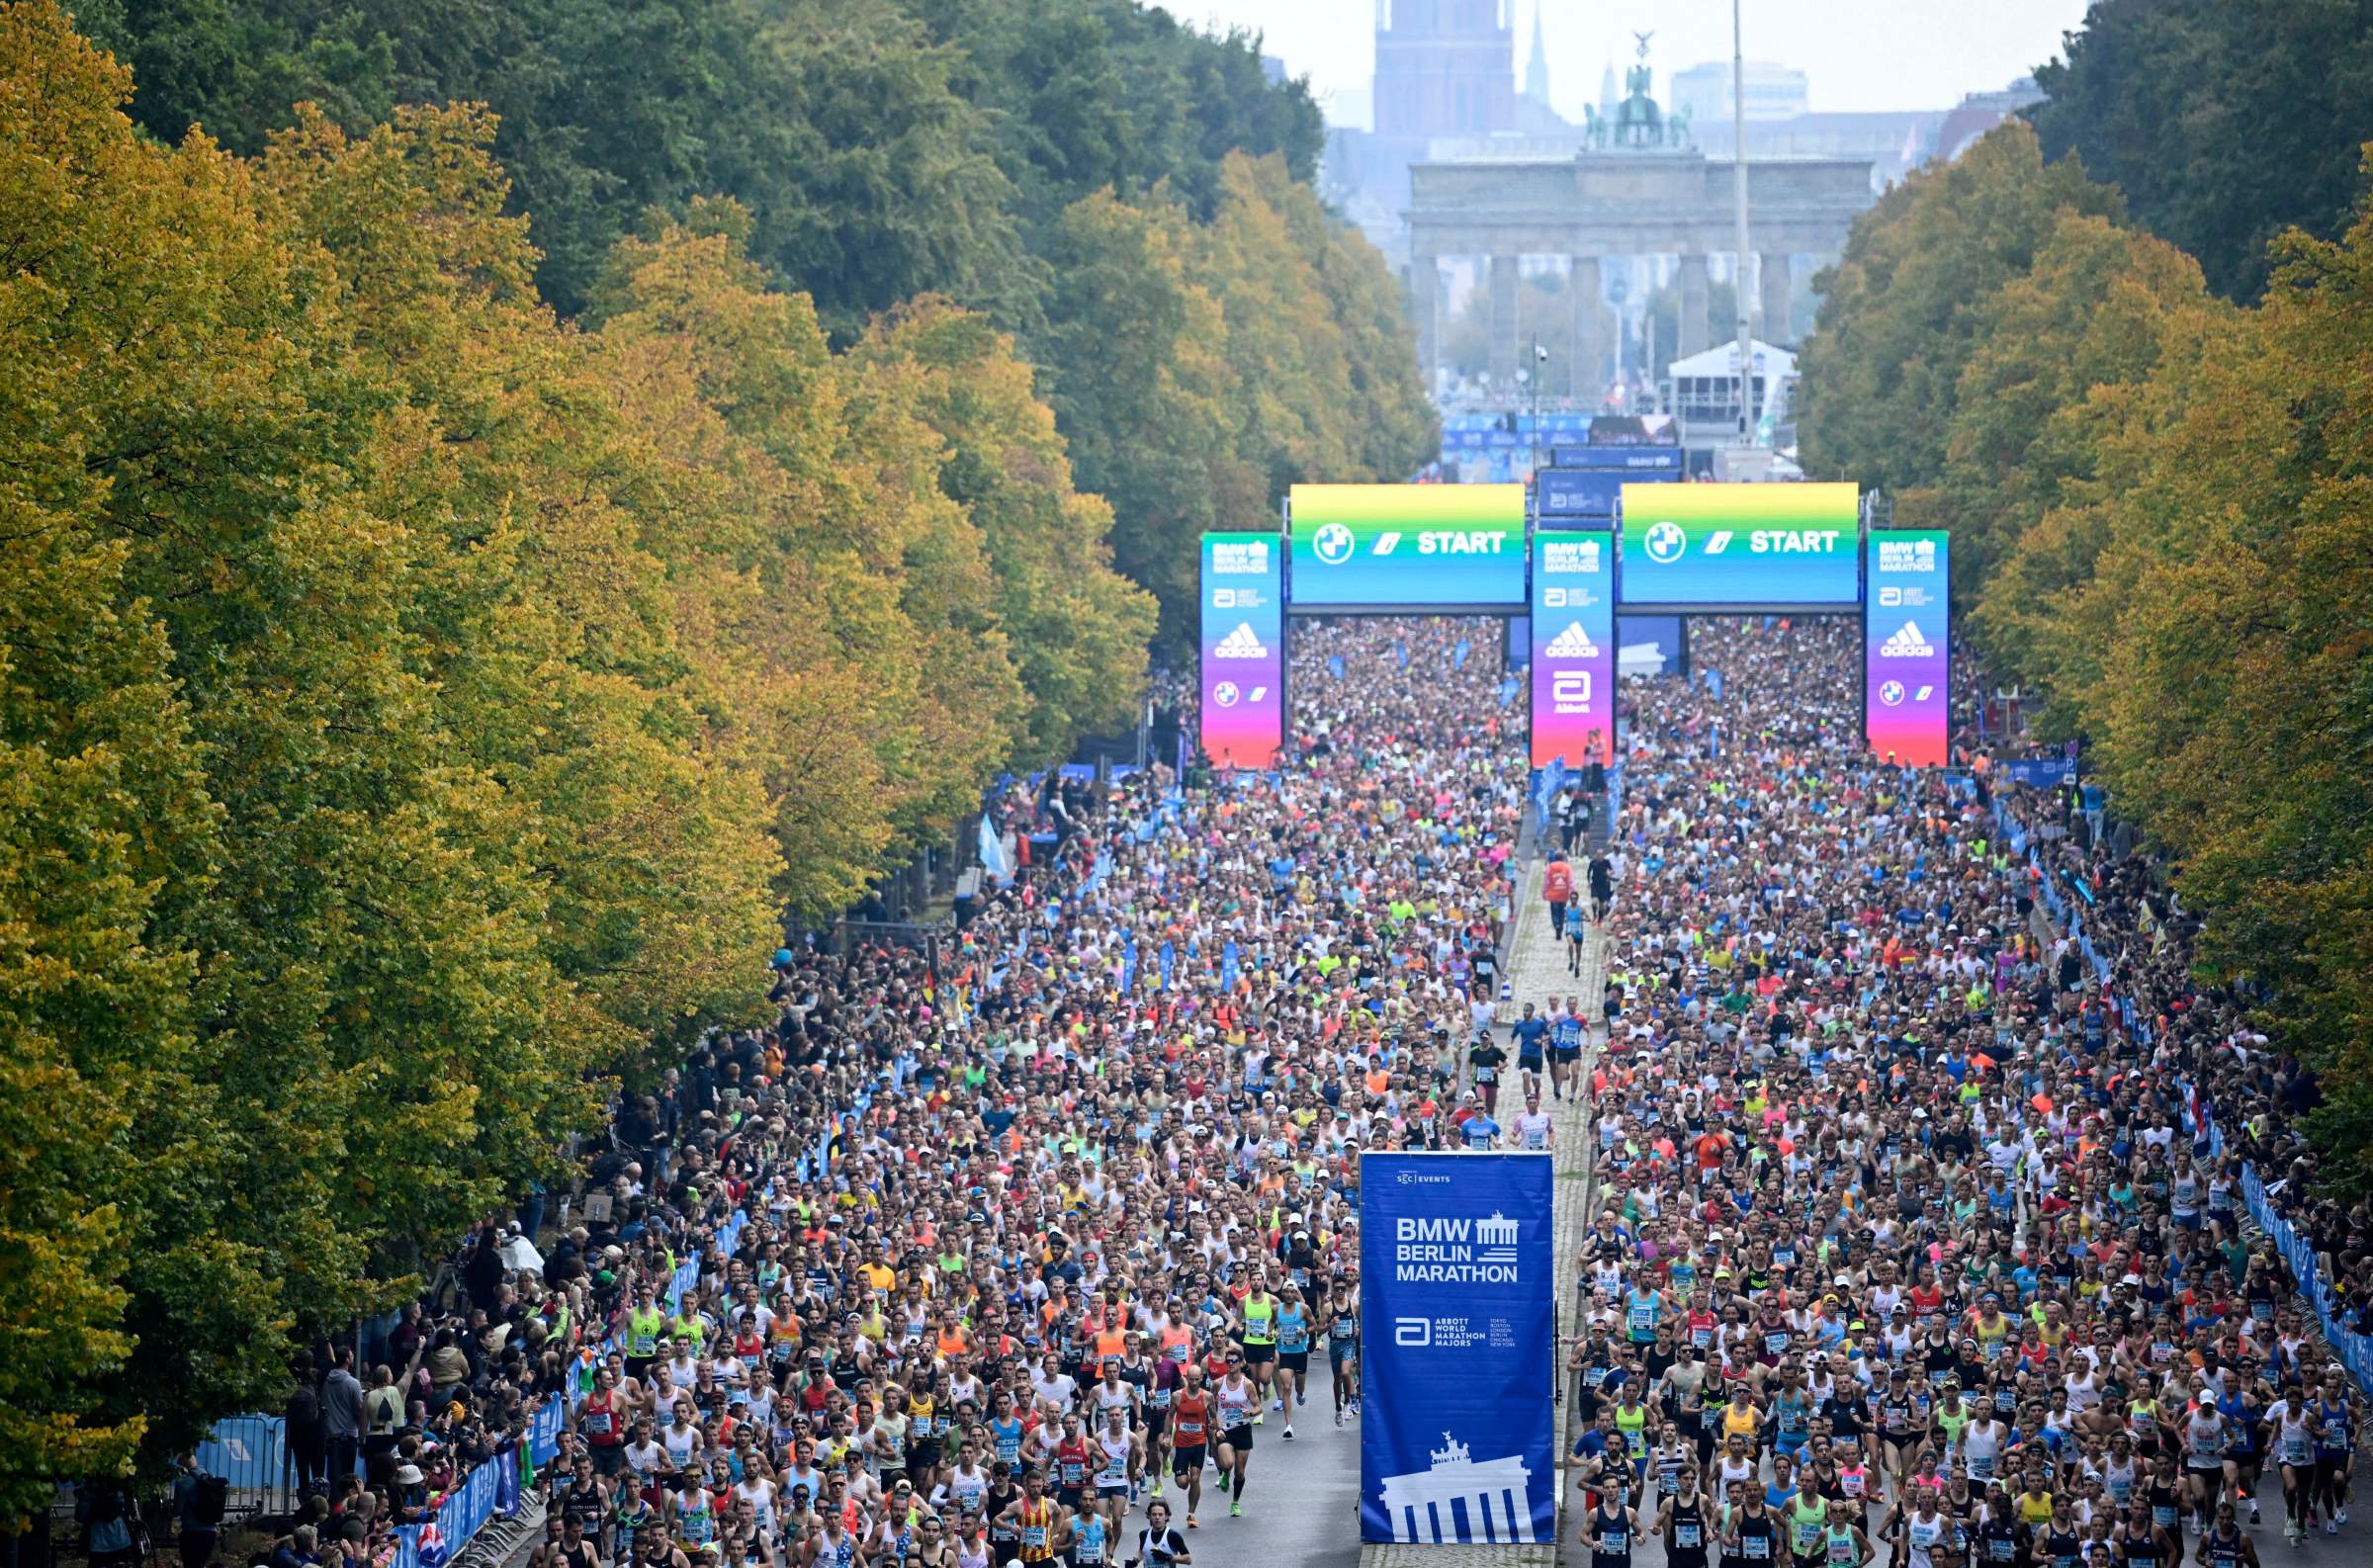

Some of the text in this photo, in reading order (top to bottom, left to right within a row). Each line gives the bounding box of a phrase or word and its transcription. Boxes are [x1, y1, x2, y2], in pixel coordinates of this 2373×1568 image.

[1418, 531, 1506, 555] START
[1750, 530, 1839, 553] START
[1879, 541, 1914, 554] BMW
[1543, 543, 1579, 555] BMW
[1879, 554, 1914, 563] BERLIN
[1543, 563, 1600, 572] MARATHON
[1879, 562, 1935, 571] MARATHON
[1214, 646, 1268, 658] adidas
[1545, 645, 1599, 658] adidas
[1881, 645, 1934, 657] adidas
[2065, 758, 2073, 771] P
[1397, 1218, 1470, 1242] BMW
[1397, 1246, 1471, 1262] BERLIN
[1397, 1265, 1518, 1282] MARATHON
